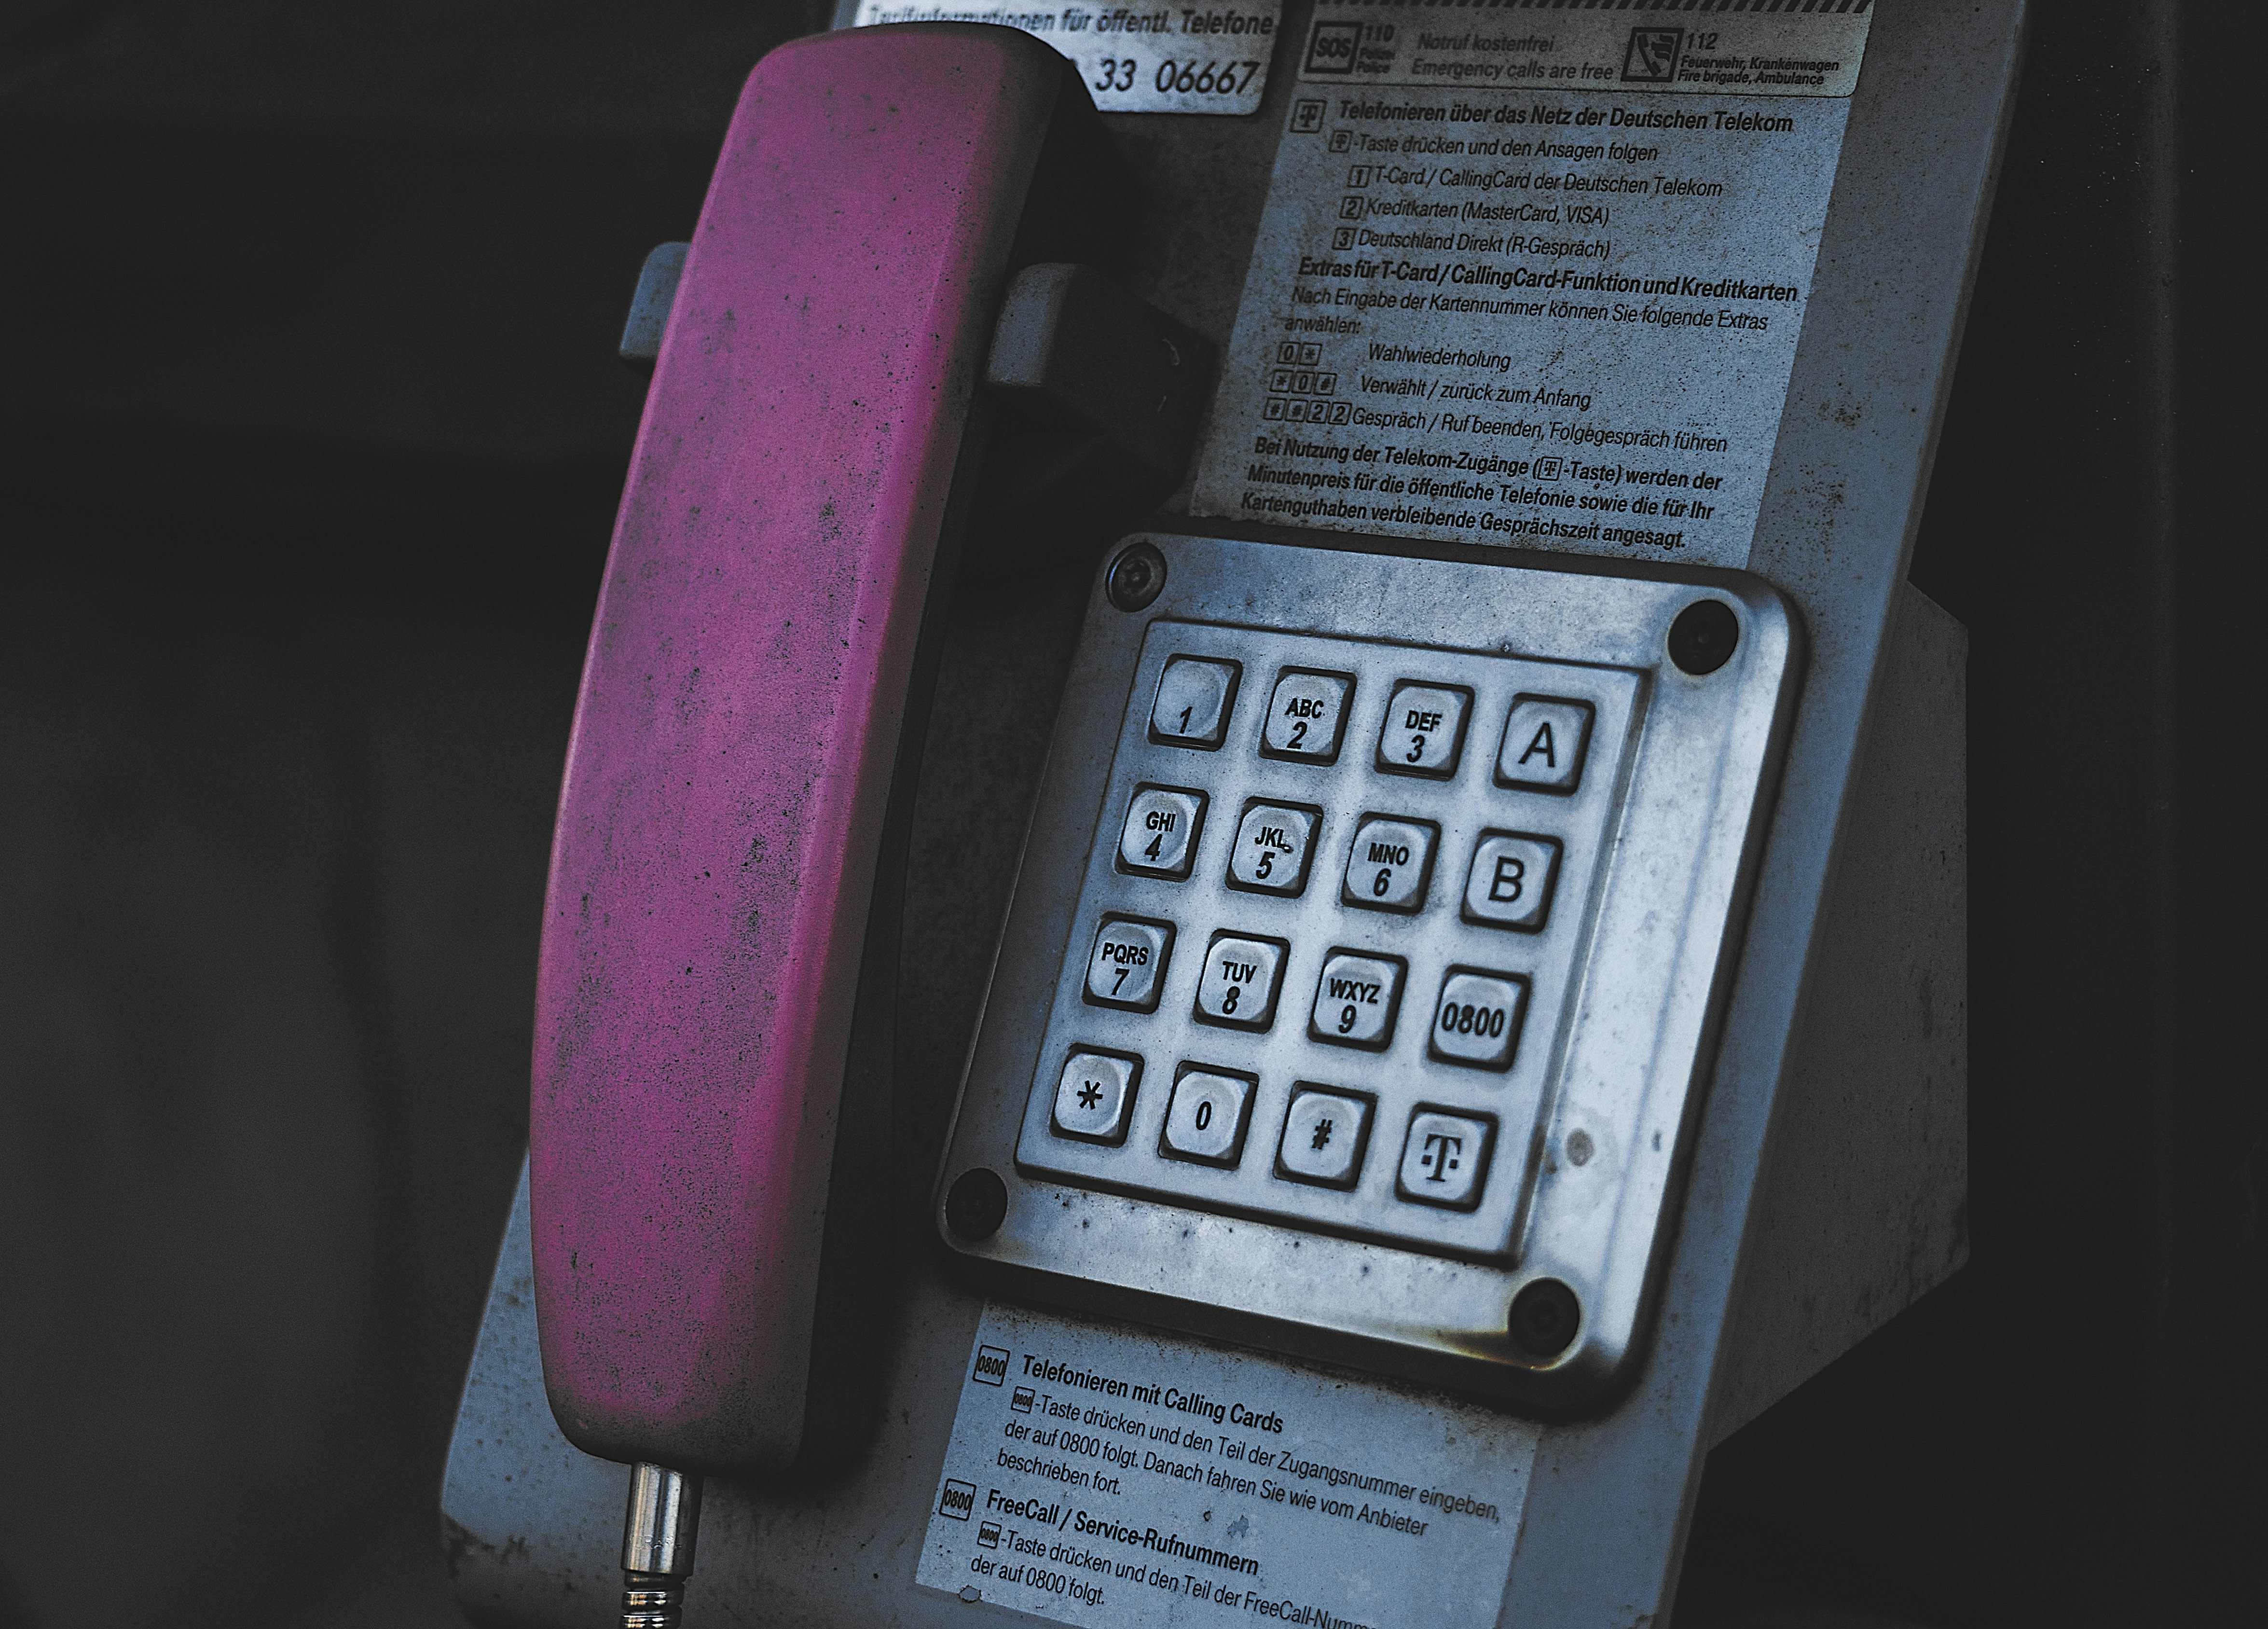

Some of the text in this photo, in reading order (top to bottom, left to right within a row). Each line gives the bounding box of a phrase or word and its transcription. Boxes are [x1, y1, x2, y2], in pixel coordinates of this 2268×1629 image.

[1064, 8, 1274, 35] für öffentl. Telefone
[1365, 25, 1394, 42] 110
[1317, 37, 1351, 58] SOS
[1419, 33, 1554, 52] Notruf kostenfrei
[1689, 33, 1718, 50] 112
[1096, 58, 1260, 94] 33 06667
[1412, 59, 1613, 80] Emergency calls are free
[1677, 70, 1824, 84] Fire brigade, Ambulance
[1681, 55, 1839, 73] Feuerwehr, Krankenwagen
[1340, 100, 1792, 132] Telefonieren über das Netz der Deutschen Telekom
[1402, 136, 1464, 154] drücken
[1470, 138, 1498, 155] und
[1501, 139, 1531, 156] den
[1535, 139, 1603, 162] Ansagen
[1608, 142, 1657, 163] folgen
[1375, 166, 1722, 197] T-Card CallingCard der Deutschen Telekom
[1366, 197, 1457, 218] Kreditkarten
[1462, 201, 1560, 225] (MasterCard,
[1567, 206, 1609, 228] VISA)
[1358, 229, 1454, 248] Deutschland
[1457, 233, 1502, 252] Direkt
[1506, 234, 1610, 260] (R-Gespräch)
[1298, 256, 1797, 302] Extras für T-Card CallingCard-Funktion und Kreditkarten
[1292, 287, 1768, 331] Nach Eingabe der Kartennummer können Sie folgende Extras
[1285, 315, 1361, 334] anwählen:
[1369, 343, 1511, 372] Wahlwiederholung
[1361, 375, 1591, 410] Verwählt zurück zum Anfang
[1353, 409, 1727, 453] Gespräch Ruf beenden, Folgegespräch führen
[1255, 437, 1281, 455] Bei
[1283, 440, 1348, 463] Nutzung
[1352, 444, 1380, 462] der
[1385, 446, 1528, 477] Telekom-Zugänge
[1626, 469, 1689, 488] werden
[1692, 471, 1722, 490] der
[1248, 464, 1714, 519] Minutenpreis für die öffentliche Telefonie sowie die für Ihr
[1242, 492, 1686, 550] Kartenguthaben verbleibende Gesprächszeit angesagt.
[1180, 706, 1192, 733] 1
[1285, 698, 1323, 718] ABC
[1405, 710, 1442, 732] DEF
[1287, 722, 1307, 749] 2
[1406, 735, 1426, 762] 3
[1518, 722, 1555, 768] A
[1146, 811, 1176, 832] GHI
[1144, 834, 1162, 861] 4
[1255, 827, 1288, 848] JKL
[1256, 851, 1275, 879] 5
[1367, 842, 1409, 865] MNO
[1373, 869, 1391, 897] 6
[1488, 856, 1525, 903] B
[1102, 942, 1148, 966] PQRS
[1112, 968, 1129, 995] 7
[1222, 961, 1256, 983] TUV
[1222, 987, 1239, 1014] 8
[1330, 978, 1380, 1005] WXYZ
[1339, 1005, 1356, 1033] 9
[1441, 1002, 1504, 1038] 0800
[1196, 1101, 1211, 1131] 0
[1311, 1119, 1332, 1150] #
[977, 1354, 1283, 1433] 0800 Telefonieren mit Calling Cards
[997, 1448, 1121, 1495] beschrieben fort.
[1005, 1420, 1429, 1536] der auf 0800 folgt. Danach fahren Sie wie vom Anbieter
[1084, 1407, 1145, 1437] drücken
[1149, 1426, 1181, 1445] und
[1183, 1430, 1212, 1452] den
[1218, 1436, 1245, 1460] Teil
[1249, 1446, 1276, 1467] der
[1277, 1450, 1417, 1502] Zugangsnummer
[1419, 1486, 1500, 1523] eingeben,
[944, 1489, 1259, 1575] 0800 FreeCall Service-Rufnummern
[971, 1555, 1104, 1605] der auf 0800 folgt.
[1050, 1544, 1111, 1574] drücken
[1115, 1562, 1145, 1582] und
[1149, 1569, 1179, 1591] den
[1183, 1575, 1211, 1600] Teil
[1214, 1585, 1241, 1607] der
